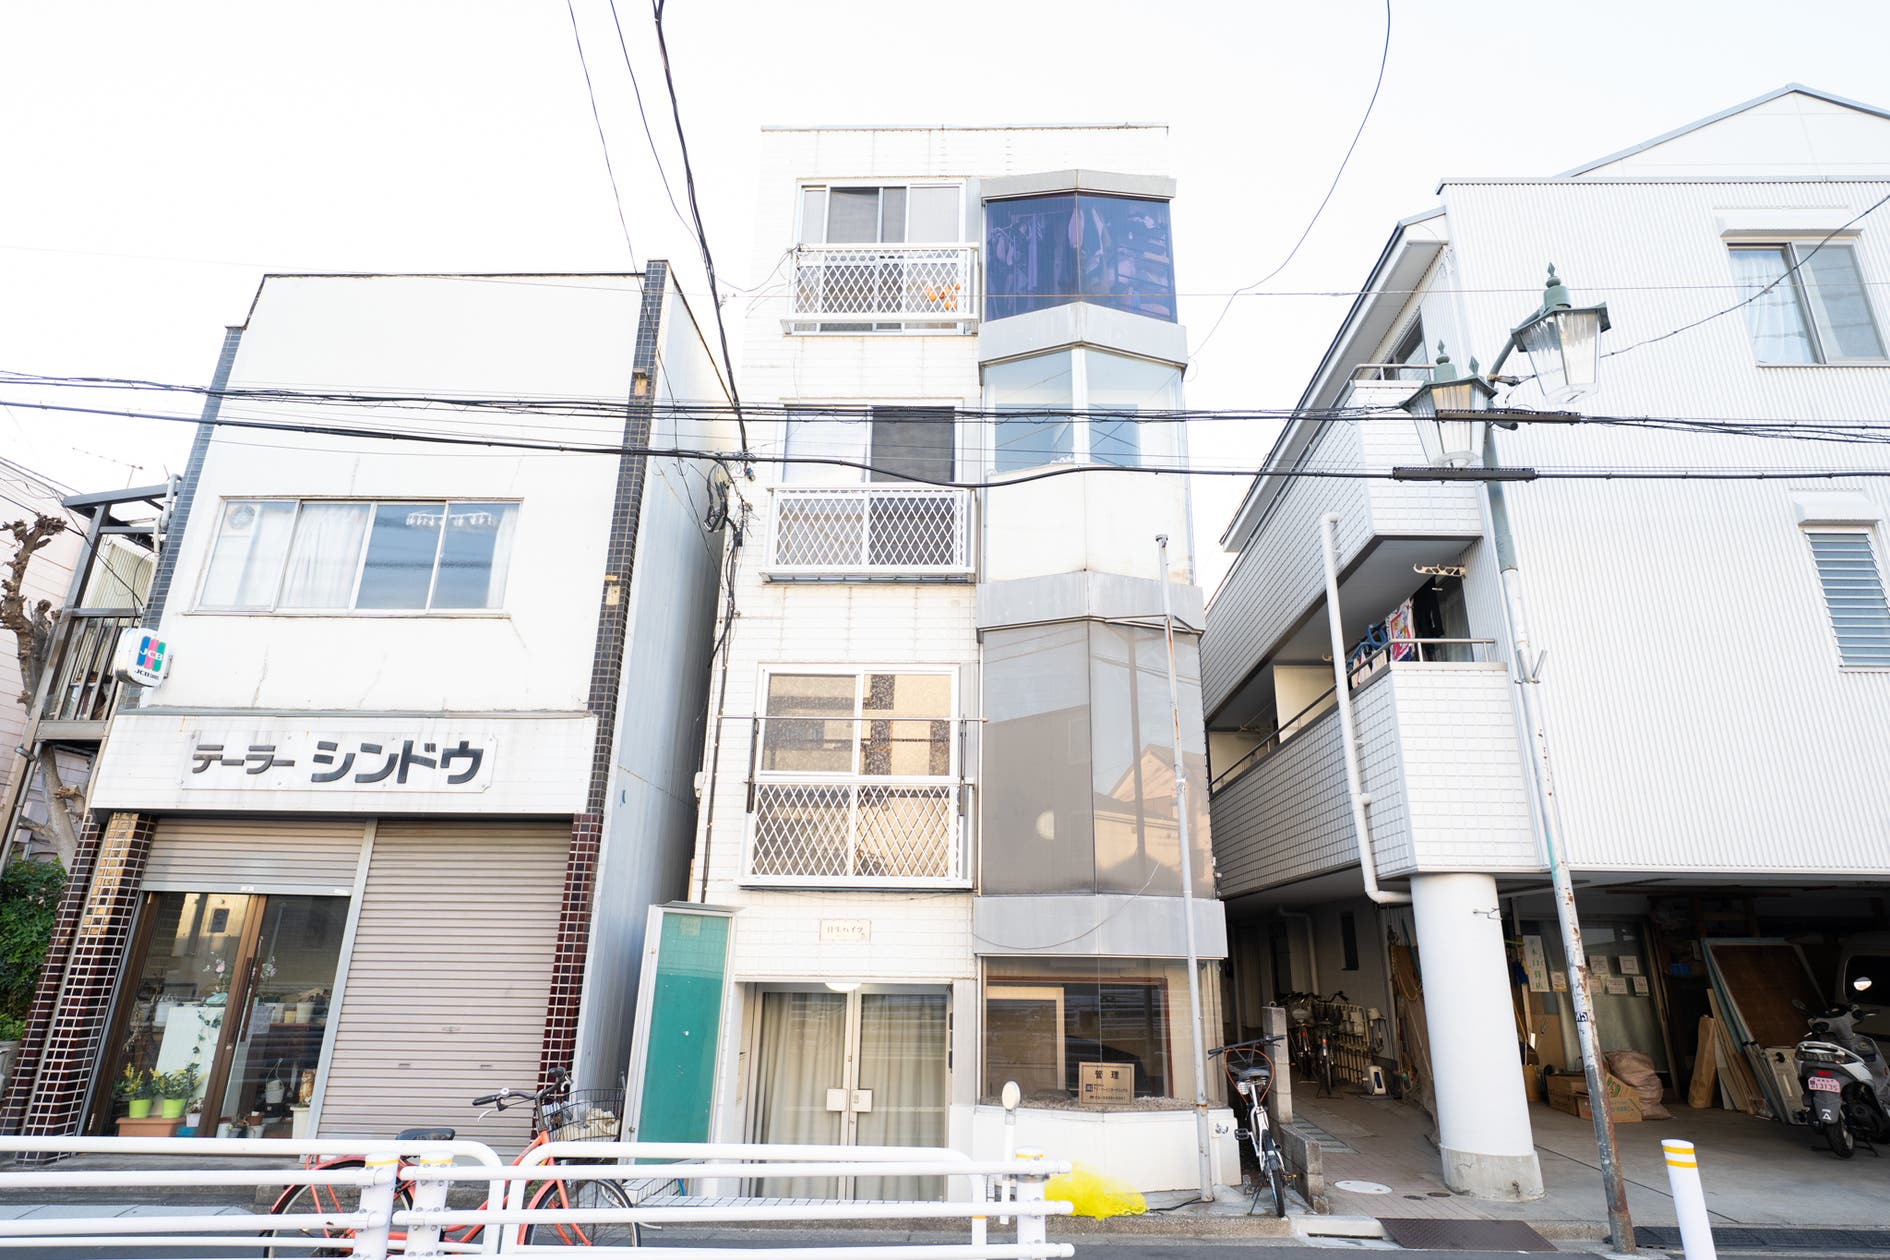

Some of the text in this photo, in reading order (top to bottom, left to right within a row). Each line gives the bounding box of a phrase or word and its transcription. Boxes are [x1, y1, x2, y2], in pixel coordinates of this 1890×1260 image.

[139, 647, 164, 661] JCB
[192, 739, 485, 785] テーラー シンドウ
